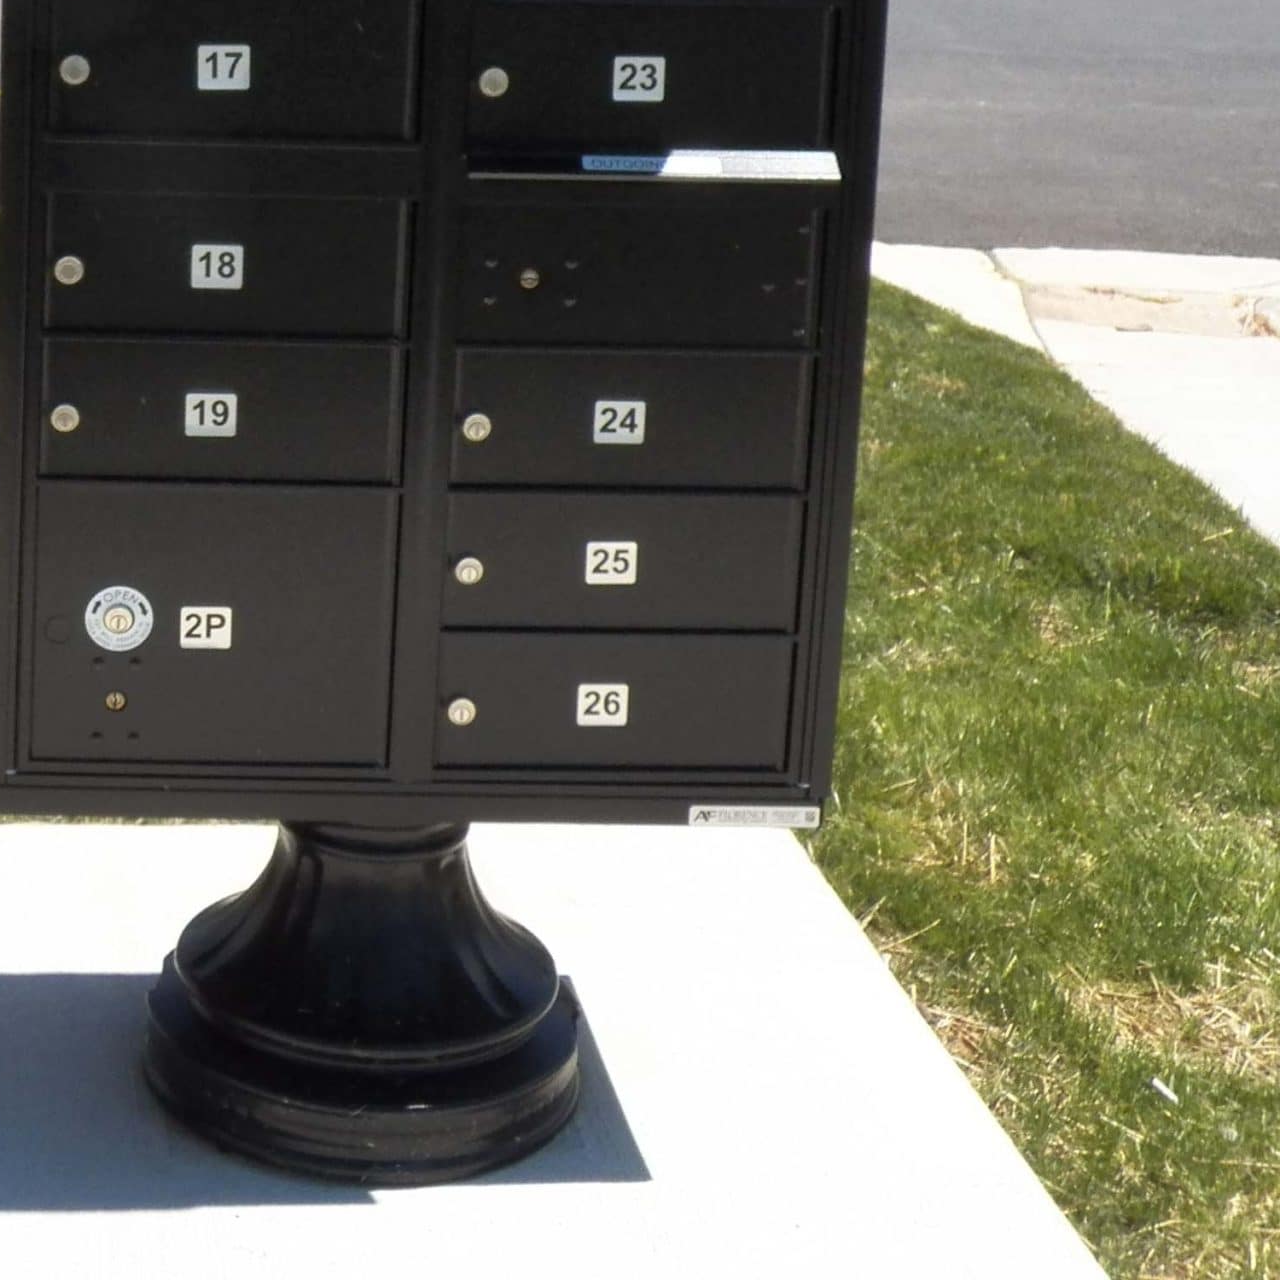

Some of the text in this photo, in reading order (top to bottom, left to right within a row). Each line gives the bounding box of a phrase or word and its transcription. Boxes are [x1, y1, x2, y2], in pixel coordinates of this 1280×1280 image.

[204, 51, 244, 80] 17
[617, 62, 658, 92] 23
[198, 250, 236, 279] 18
[192, 399, 230, 427] 19
[599, 407, 638, 434] 24
[592, 549, 629, 574] 25
[103, 589, 140, 605] OPEN
[185, 613, 226, 638] 2P
[583, 691, 620, 716] 26
